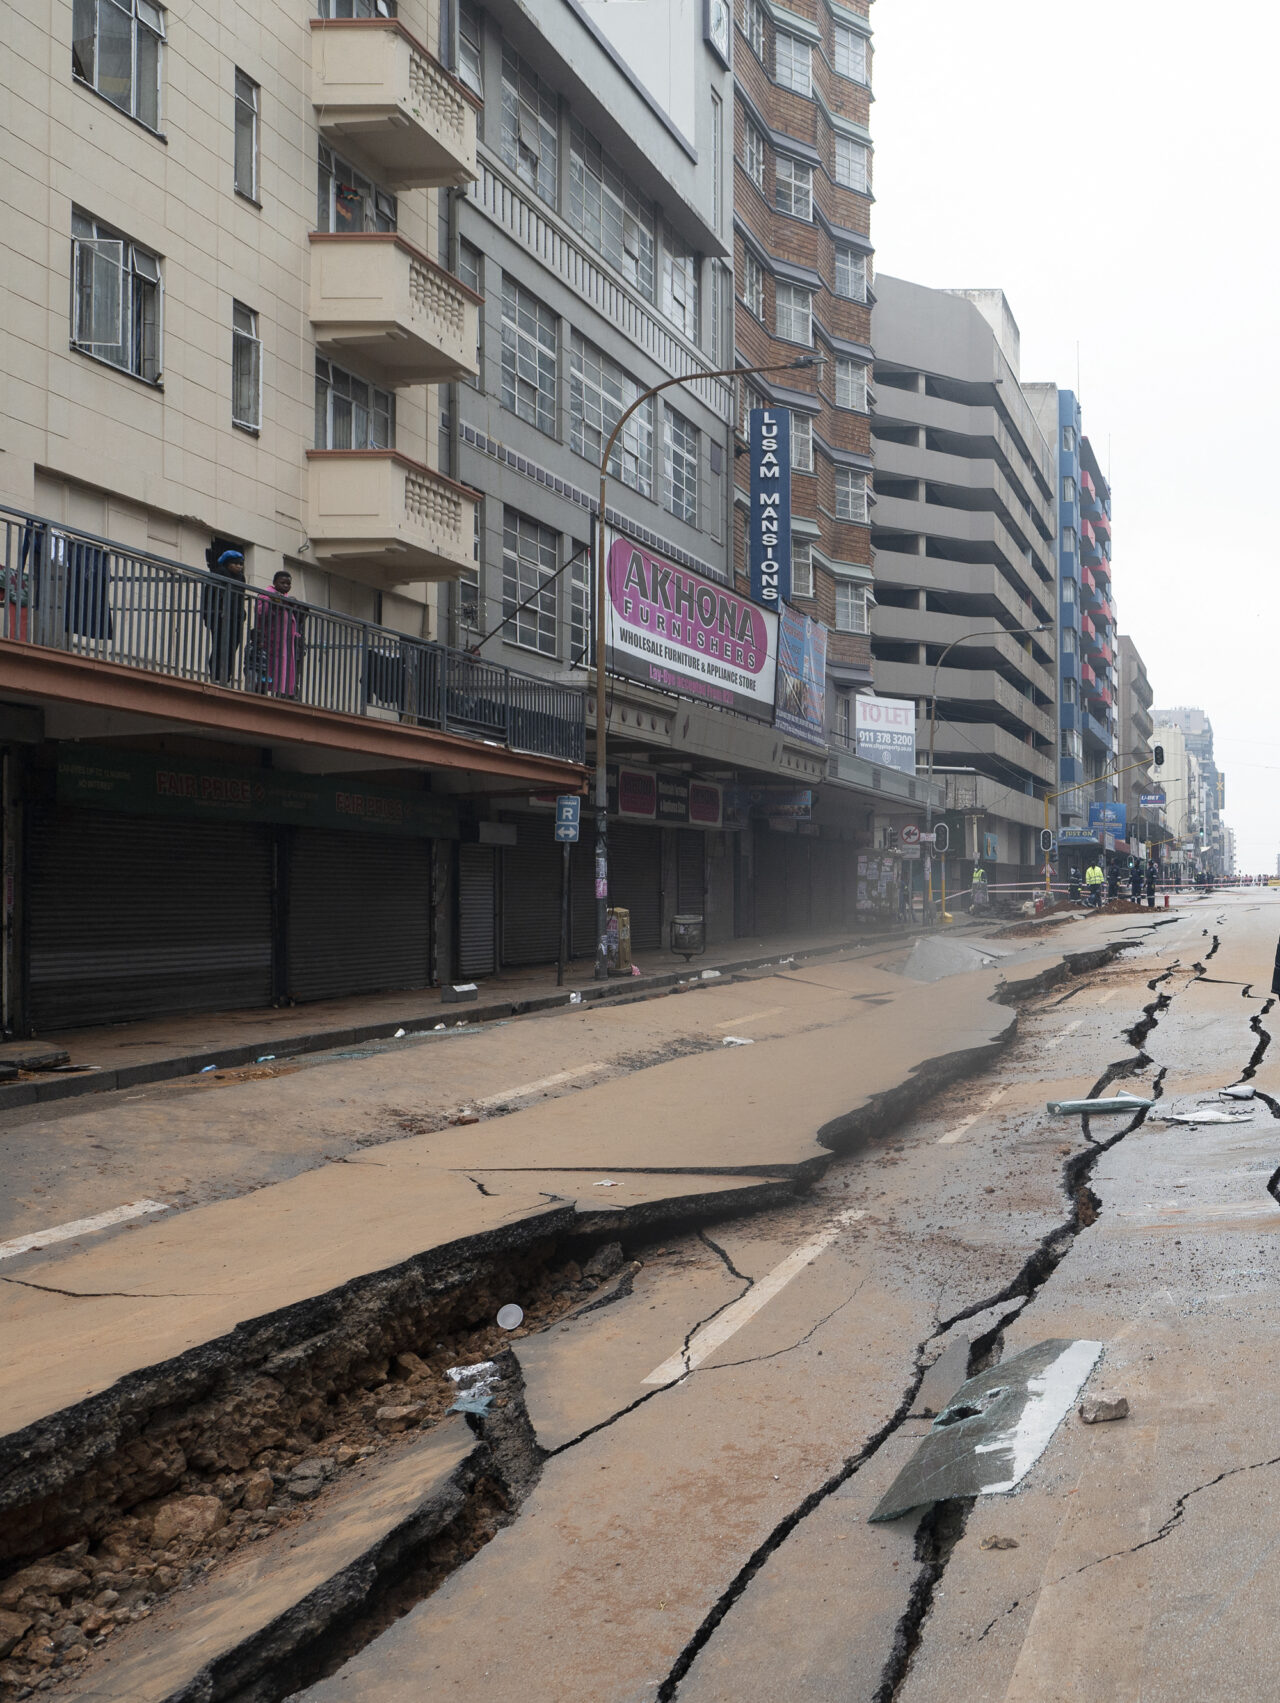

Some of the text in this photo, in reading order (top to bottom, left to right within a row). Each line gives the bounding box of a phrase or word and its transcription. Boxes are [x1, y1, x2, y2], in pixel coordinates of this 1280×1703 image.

[759, 411, 780, 600] LUSAM MANSIONS
[623, 549, 756, 650] AKHONA
[623, 597, 756, 669] FURNISHERS
[619, 627, 756, 692] WHOLESALE FURNITURE & APPLIANCE STORE
[860, 702, 911, 726] TO LET
[876, 732, 891, 744] 378
[892, 734, 912, 746] 3200
[156, 770, 198, 798] FAIR
[200, 775, 250, 802] PRICE
[335, 791, 364, 815] FAIR
[366, 795, 402, 818] PRICE
[562, 807, 573, 820] R
